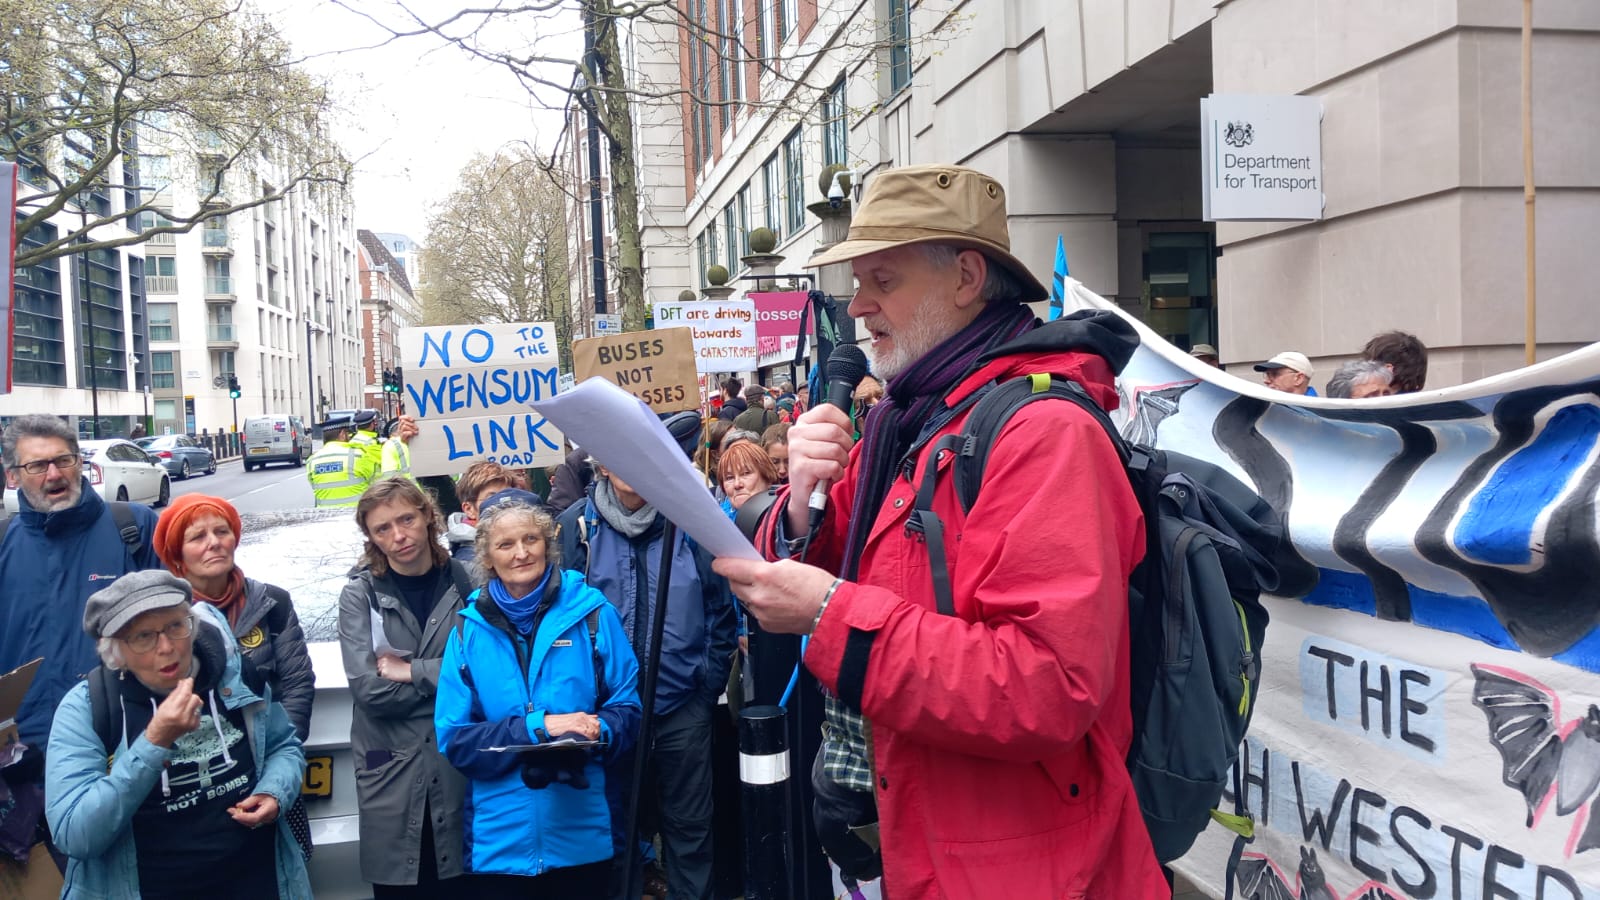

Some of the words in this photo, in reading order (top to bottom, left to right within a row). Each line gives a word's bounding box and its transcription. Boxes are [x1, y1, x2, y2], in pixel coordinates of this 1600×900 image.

[1224, 153, 1311, 171] Department
[1224, 174, 1246, 189] for
[1250, 174, 1317, 192] Transport
[660, 307, 683, 320] DFT
[686, 309, 710, 320] are
[714, 306, 752, 322] driving
[516, 326, 544, 341] TO
[693, 326, 742, 339] towards
[419, 328, 494, 368] NO
[513, 342, 549, 359] THE
[598, 339, 664, 365] BUSES
[700, 346, 756, 358] CATASTROPHE
[616, 366, 653, 387] NOT
[406, 367, 558, 418] WENSUM
[633, 385, 685, 405] SSES
[443, 414, 559, 461] LINK
[1308, 645, 1435, 752] THE
[166, 796, 199, 813] NOT
[206, 775, 249, 800] BOMBS
